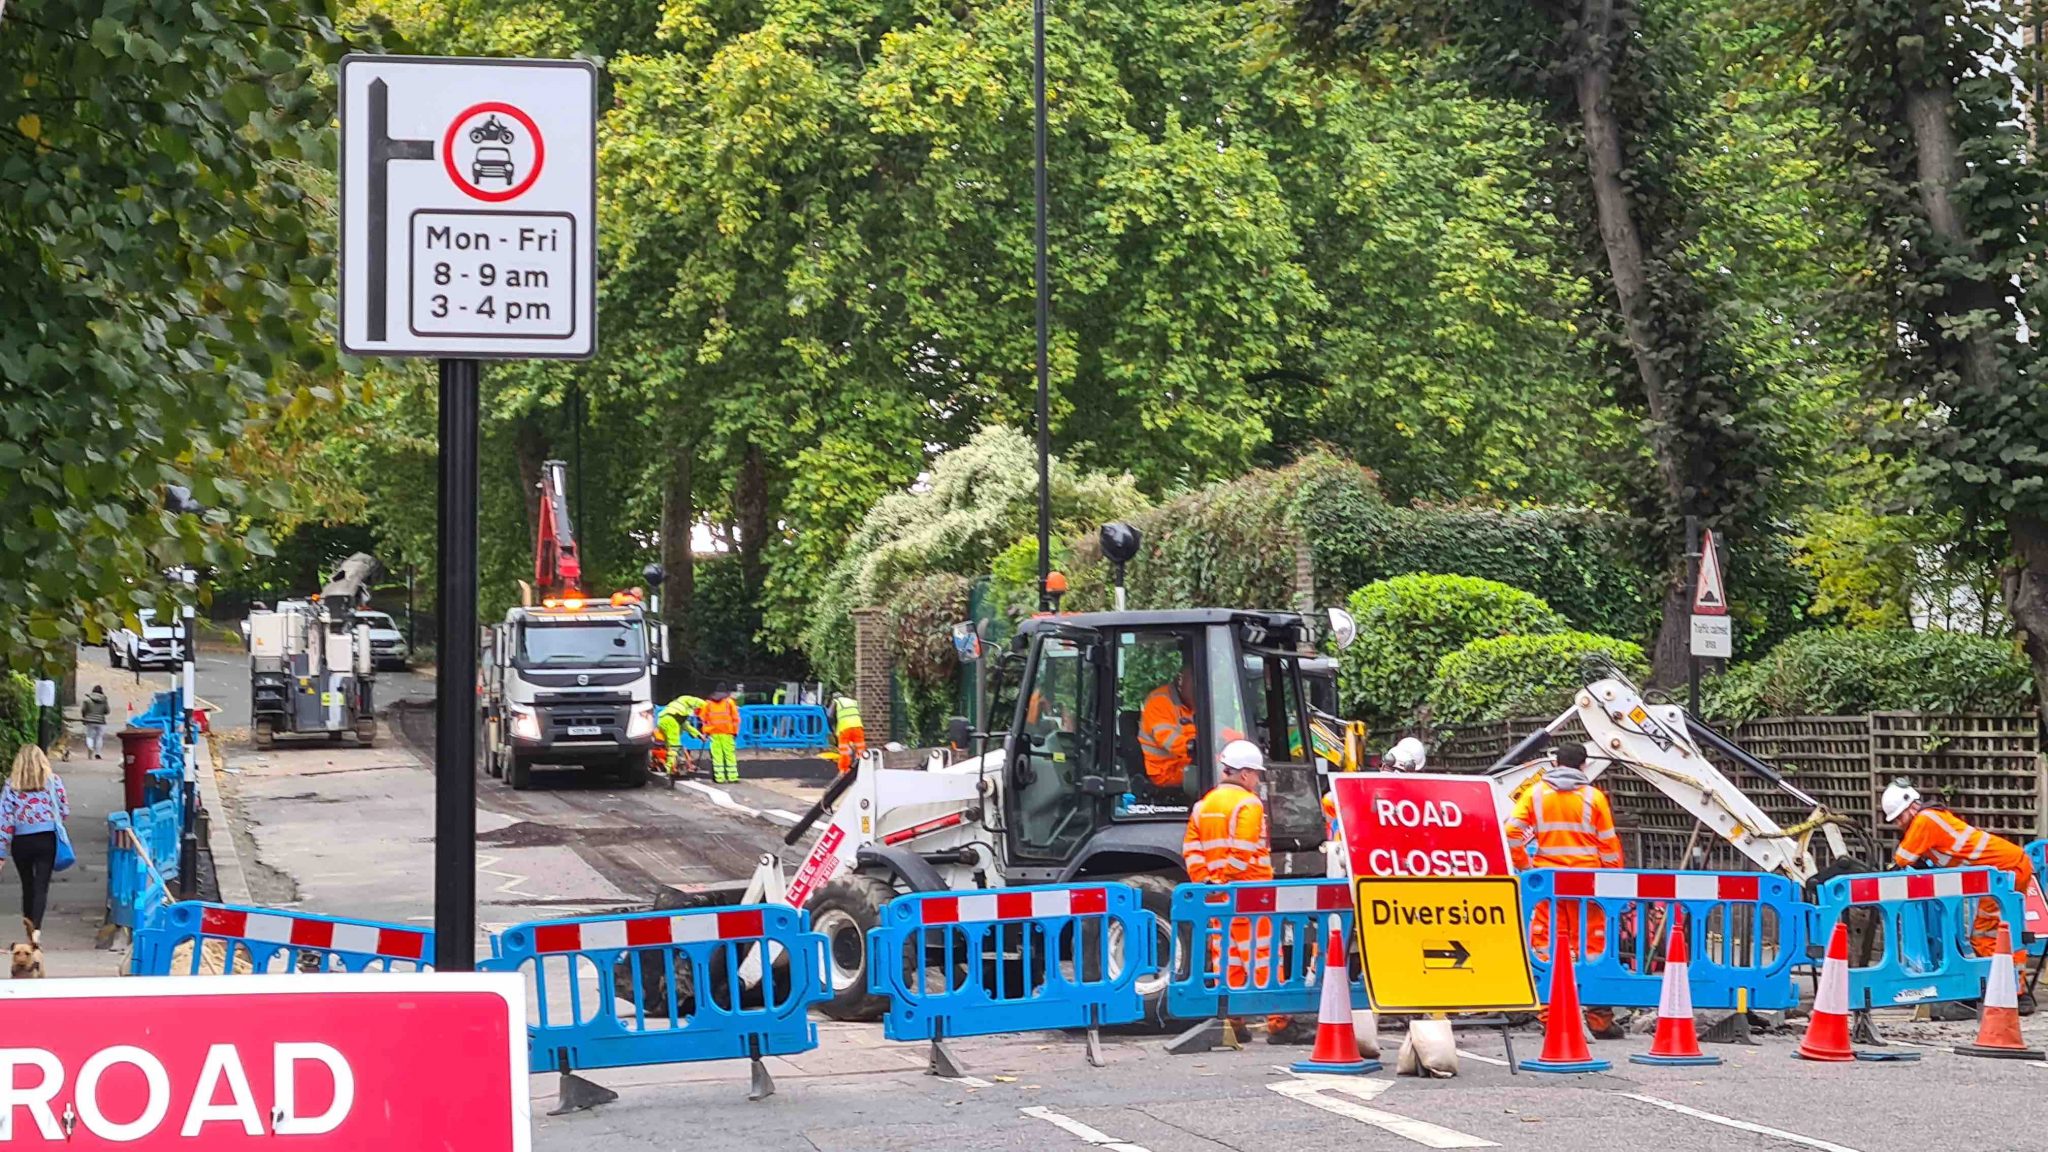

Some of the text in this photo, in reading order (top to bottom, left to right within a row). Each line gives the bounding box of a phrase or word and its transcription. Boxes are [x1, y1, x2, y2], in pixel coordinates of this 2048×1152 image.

[426, 226, 490, 250] Mon
[518, 228, 558, 252] Fri
[434, 262, 451, 285] 8
[479, 263, 497, 287] 9
[506, 268, 549, 288] am
[431, 294, 448, 318] 3
[475, 295, 497, 319] 4
[506, 301, 550, 324] pm
[1376, 799, 1463, 828] ROAD
[787, 863, 816, 901] CLEE
[814, 830, 839, 862] HILL
[1369, 848, 1489, 876] CLOSED
[1371, 899, 1506, 925] Diversion
[0, 1041, 355, 1142] ROAD
